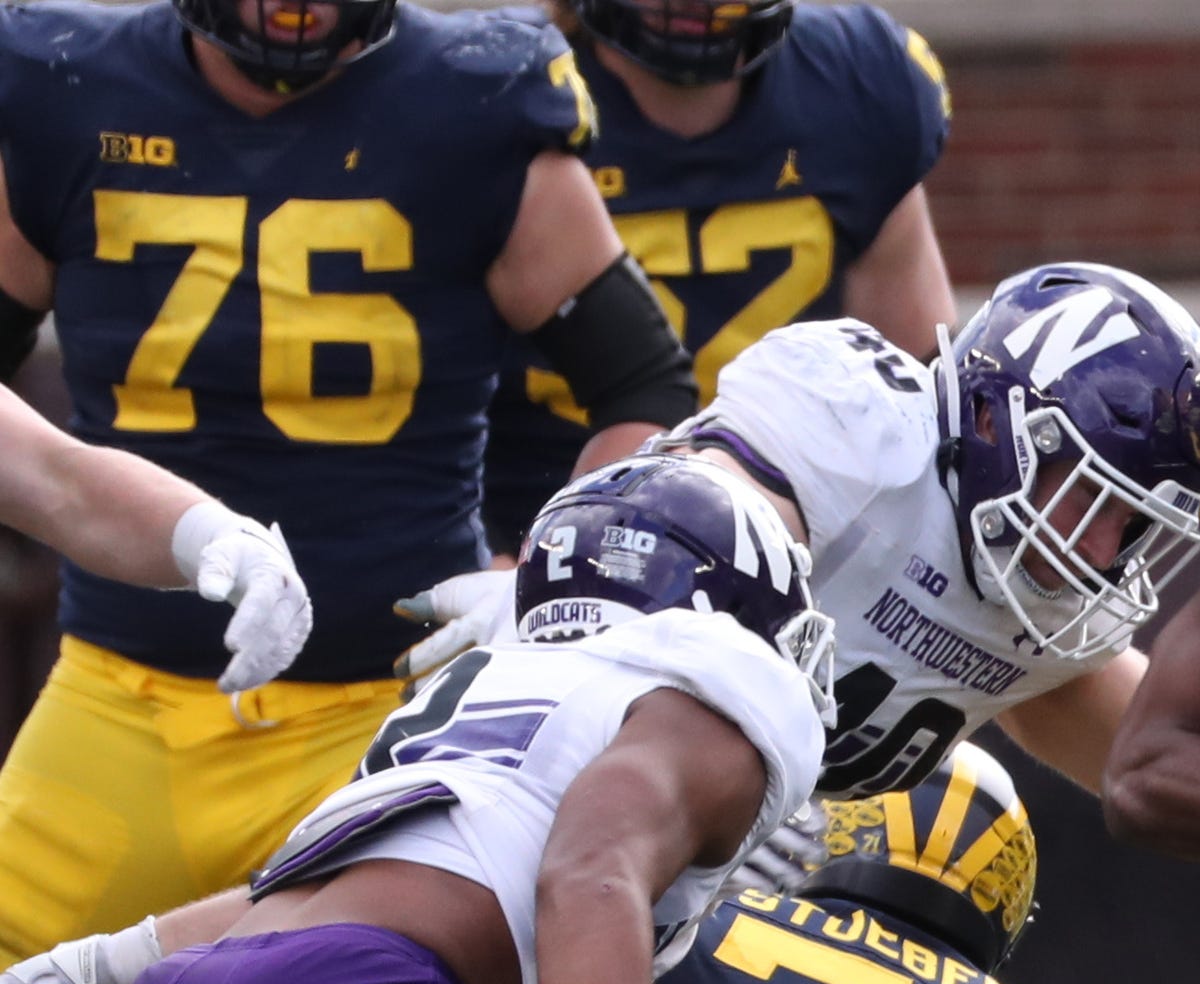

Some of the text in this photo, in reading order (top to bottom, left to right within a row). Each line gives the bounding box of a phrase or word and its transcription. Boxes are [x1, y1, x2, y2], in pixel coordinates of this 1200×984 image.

[93, 190, 421, 445] 76
[547, 525, 577, 583] 2
[528, 602, 602, 633] WILDCATS
[863, 587, 1028, 696] NORTHWESTERN
